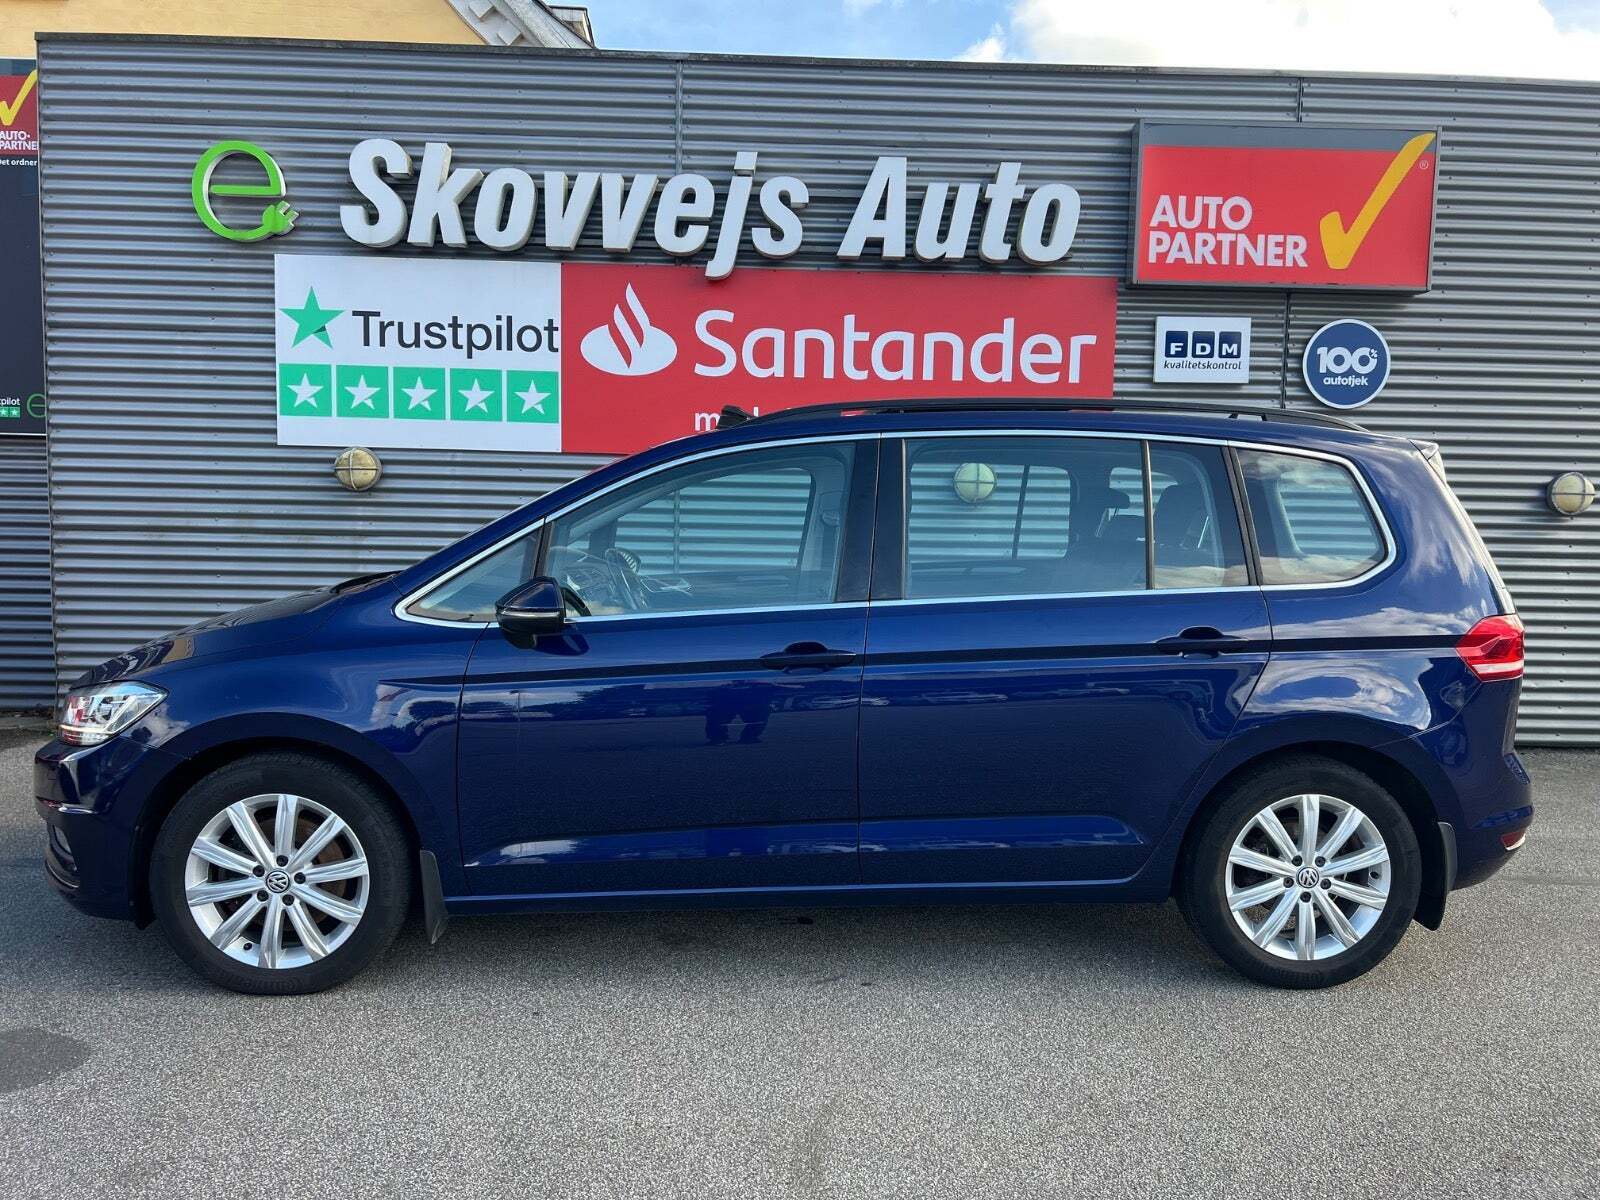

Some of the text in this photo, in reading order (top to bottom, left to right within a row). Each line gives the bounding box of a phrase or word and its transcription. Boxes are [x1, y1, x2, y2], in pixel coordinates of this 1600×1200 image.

[0, 140, 39, 150] PARTNE
[339, 138, 1082, 280] Skovvejs Auto
[1149, 194, 1253, 230] AUTO
[1147, 231, 1308, 268] PARTNER
[351, 310, 560, 359] Trustpilot
[693, 308, 1098, 385] Santander
[1163, 360, 1242, 370] kvalitetskontrol
